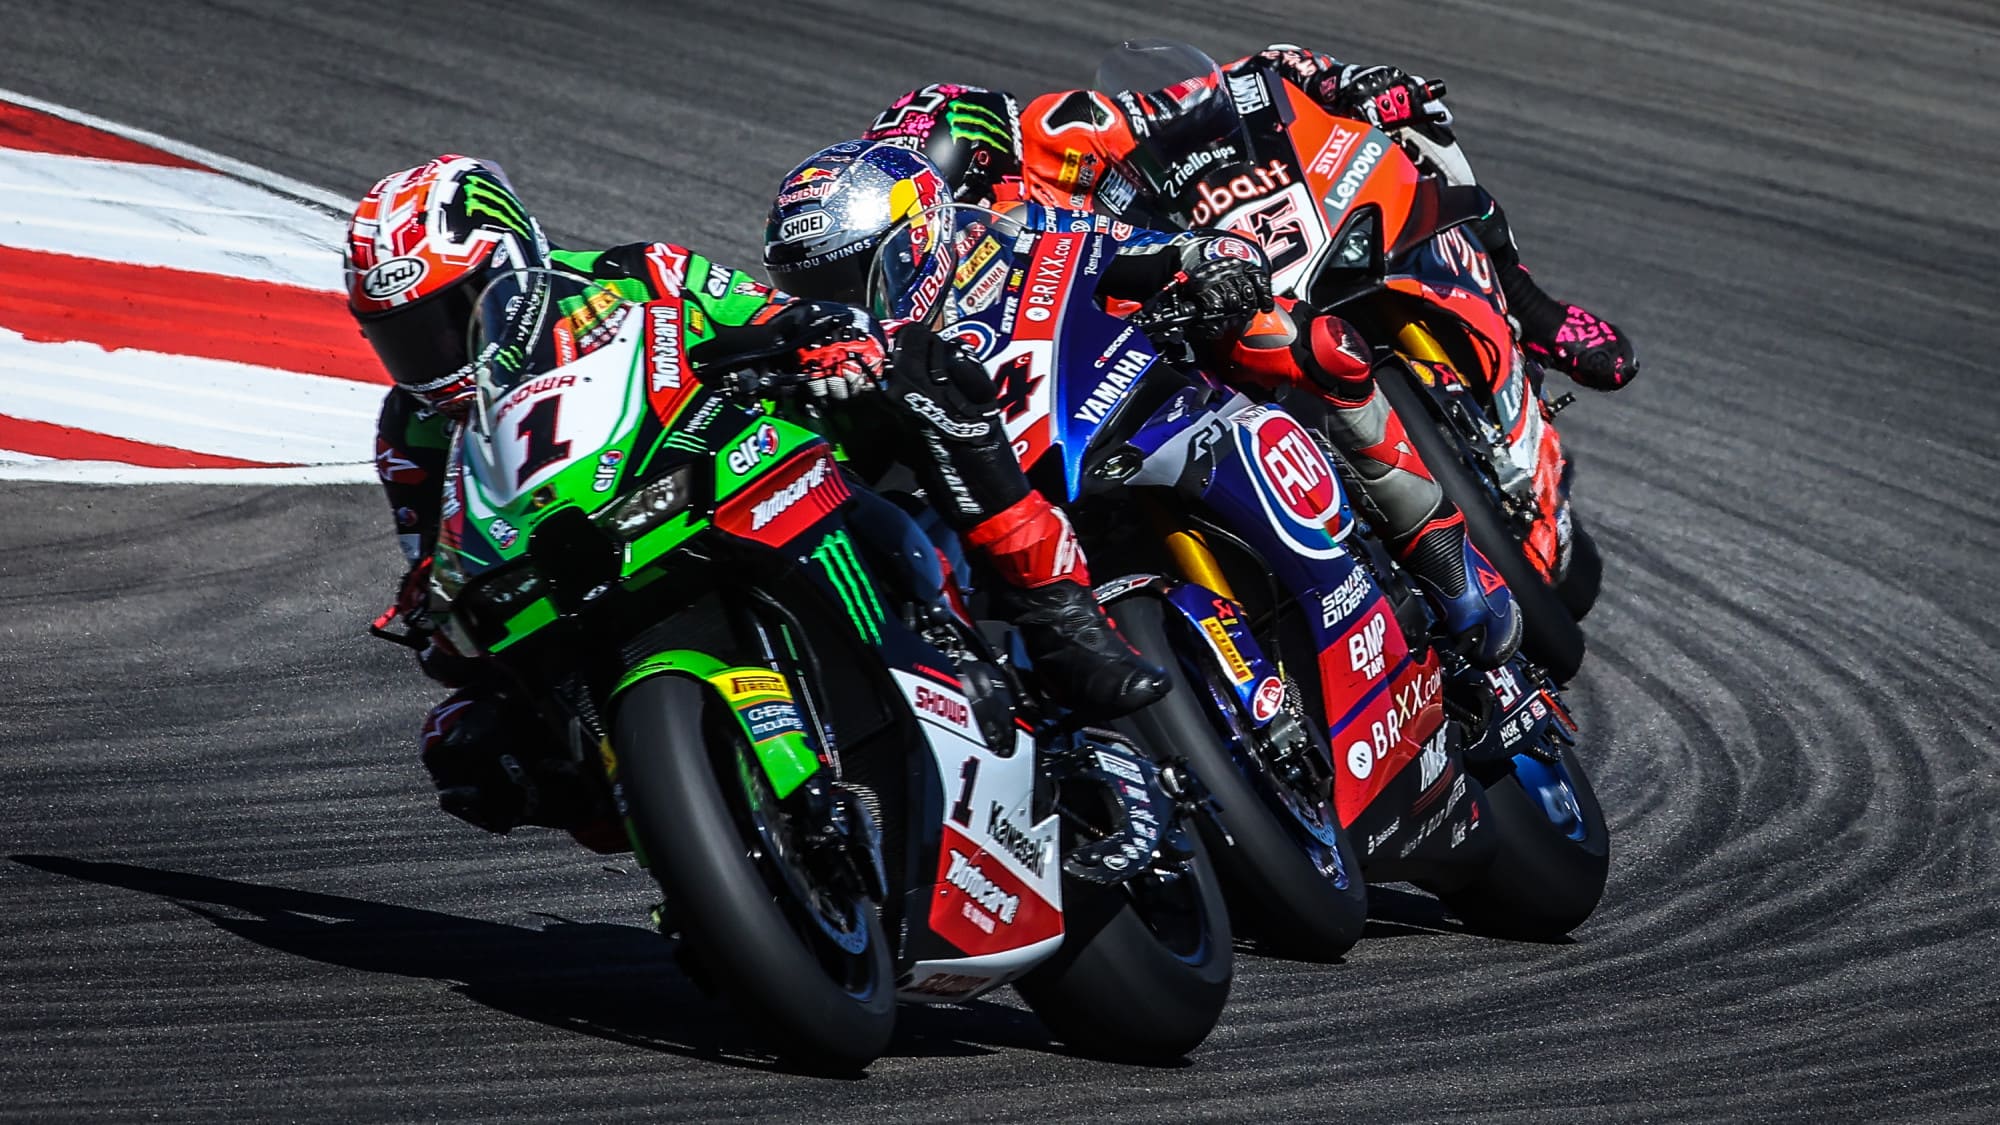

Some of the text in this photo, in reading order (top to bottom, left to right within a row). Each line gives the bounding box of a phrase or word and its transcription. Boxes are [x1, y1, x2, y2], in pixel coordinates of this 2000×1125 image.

[1173, 146, 1236, 187] riello ups
[1324, 142, 1382, 210] Lenovo
[802, 183, 832, 200] Bull
[1188, 160, 1291, 229] uba.it
[783, 215, 823, 239] SHOEI
[796, 257, 820, 271] YOU
[825, 239, 871, 263] WINGS
[921, 242, 951, 308] Bull
[364, 261, 418, 294] Arai
[972, 267, 1005, 300] YAMAHA
[1094, 325, 1135, 369] CRESCENT
[1073, 349, 1153, 425] YAMAHA
[515, 393, 574, 490] 1
[728, 441, 761, 475] elf
[1264, 429, 1327, 506] PATA
[1349, 612, 1386, 672] BMP
[915, 685, 969, 729] SHOWA
[1485, 665, 1522, 709] 54
[1499, 719, 1521, 743] NGK
[951, 756, 981, 828] 1
